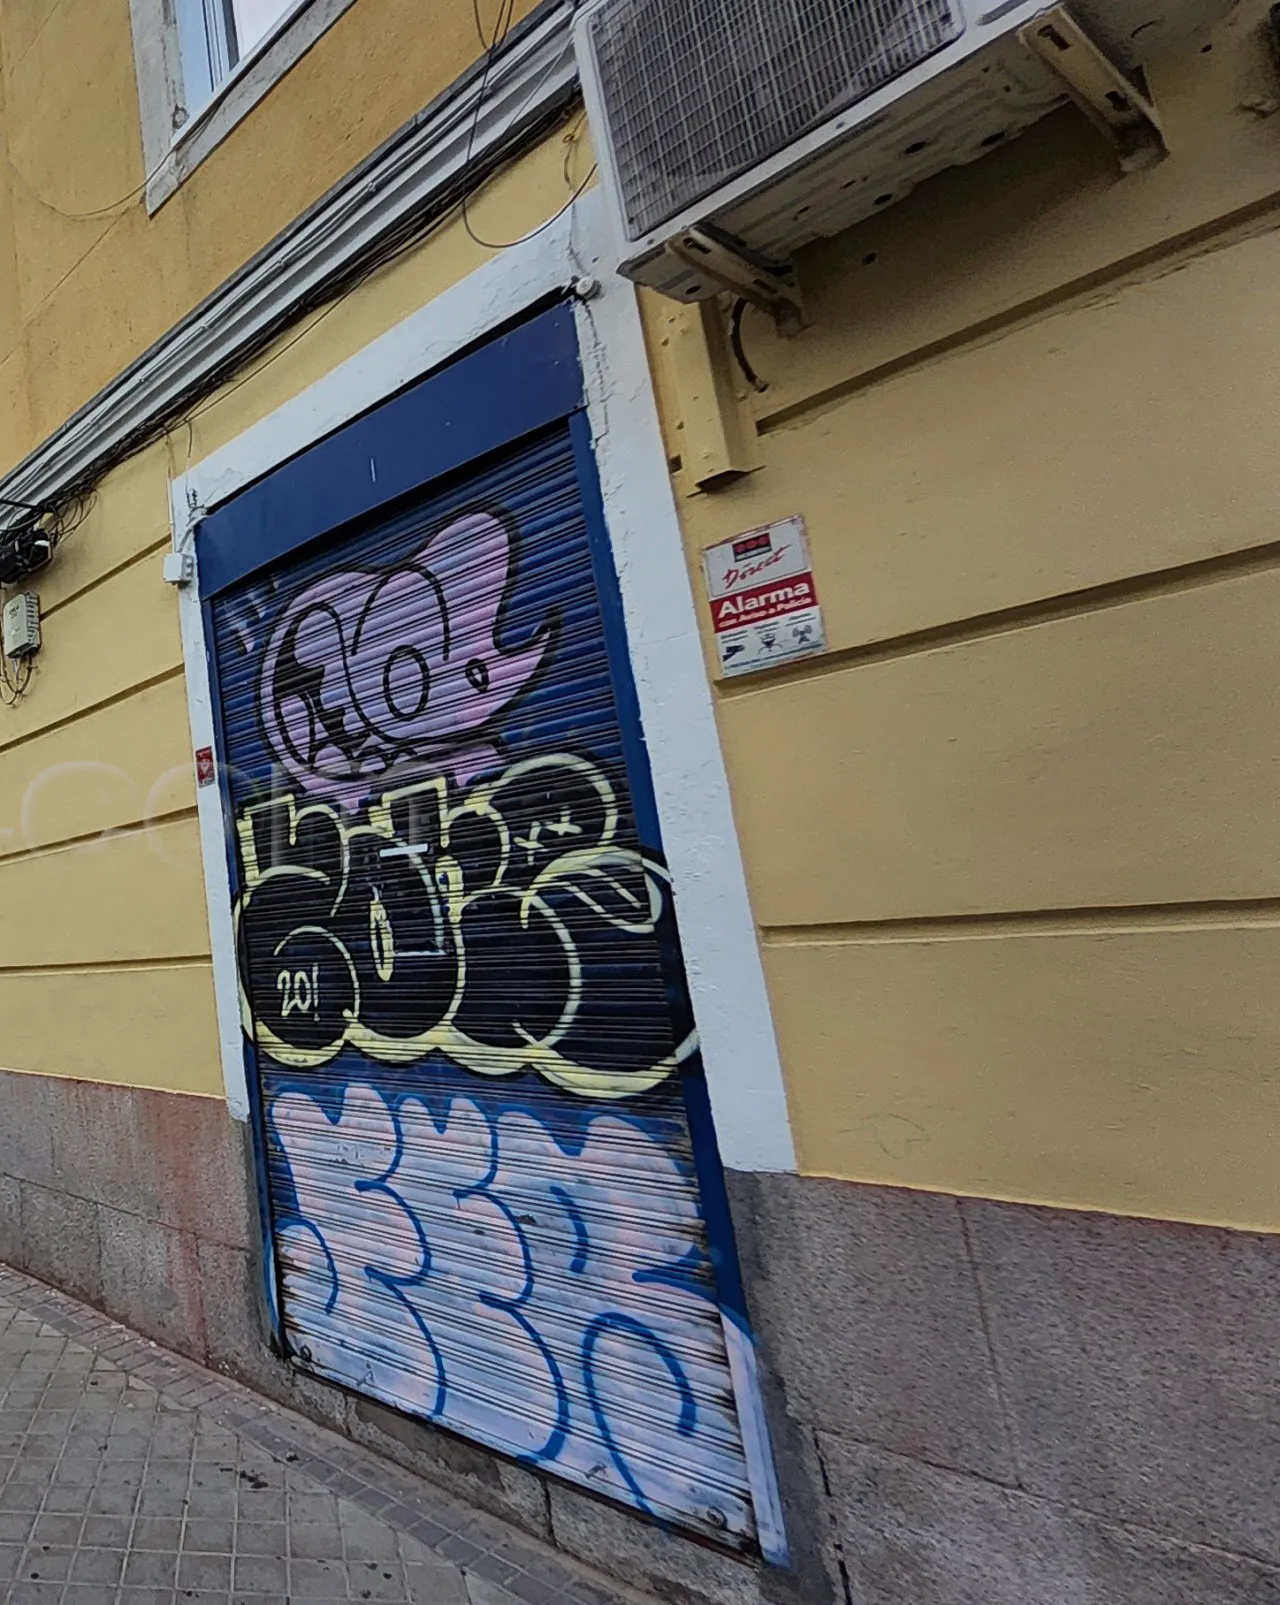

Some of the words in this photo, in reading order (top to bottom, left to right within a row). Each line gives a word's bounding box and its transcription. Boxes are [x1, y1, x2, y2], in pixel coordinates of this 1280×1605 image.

[717, 582, 811, 619] Alarma
[719, 618, 737, 628] con
[739, 609, 767, 622] Aviso
